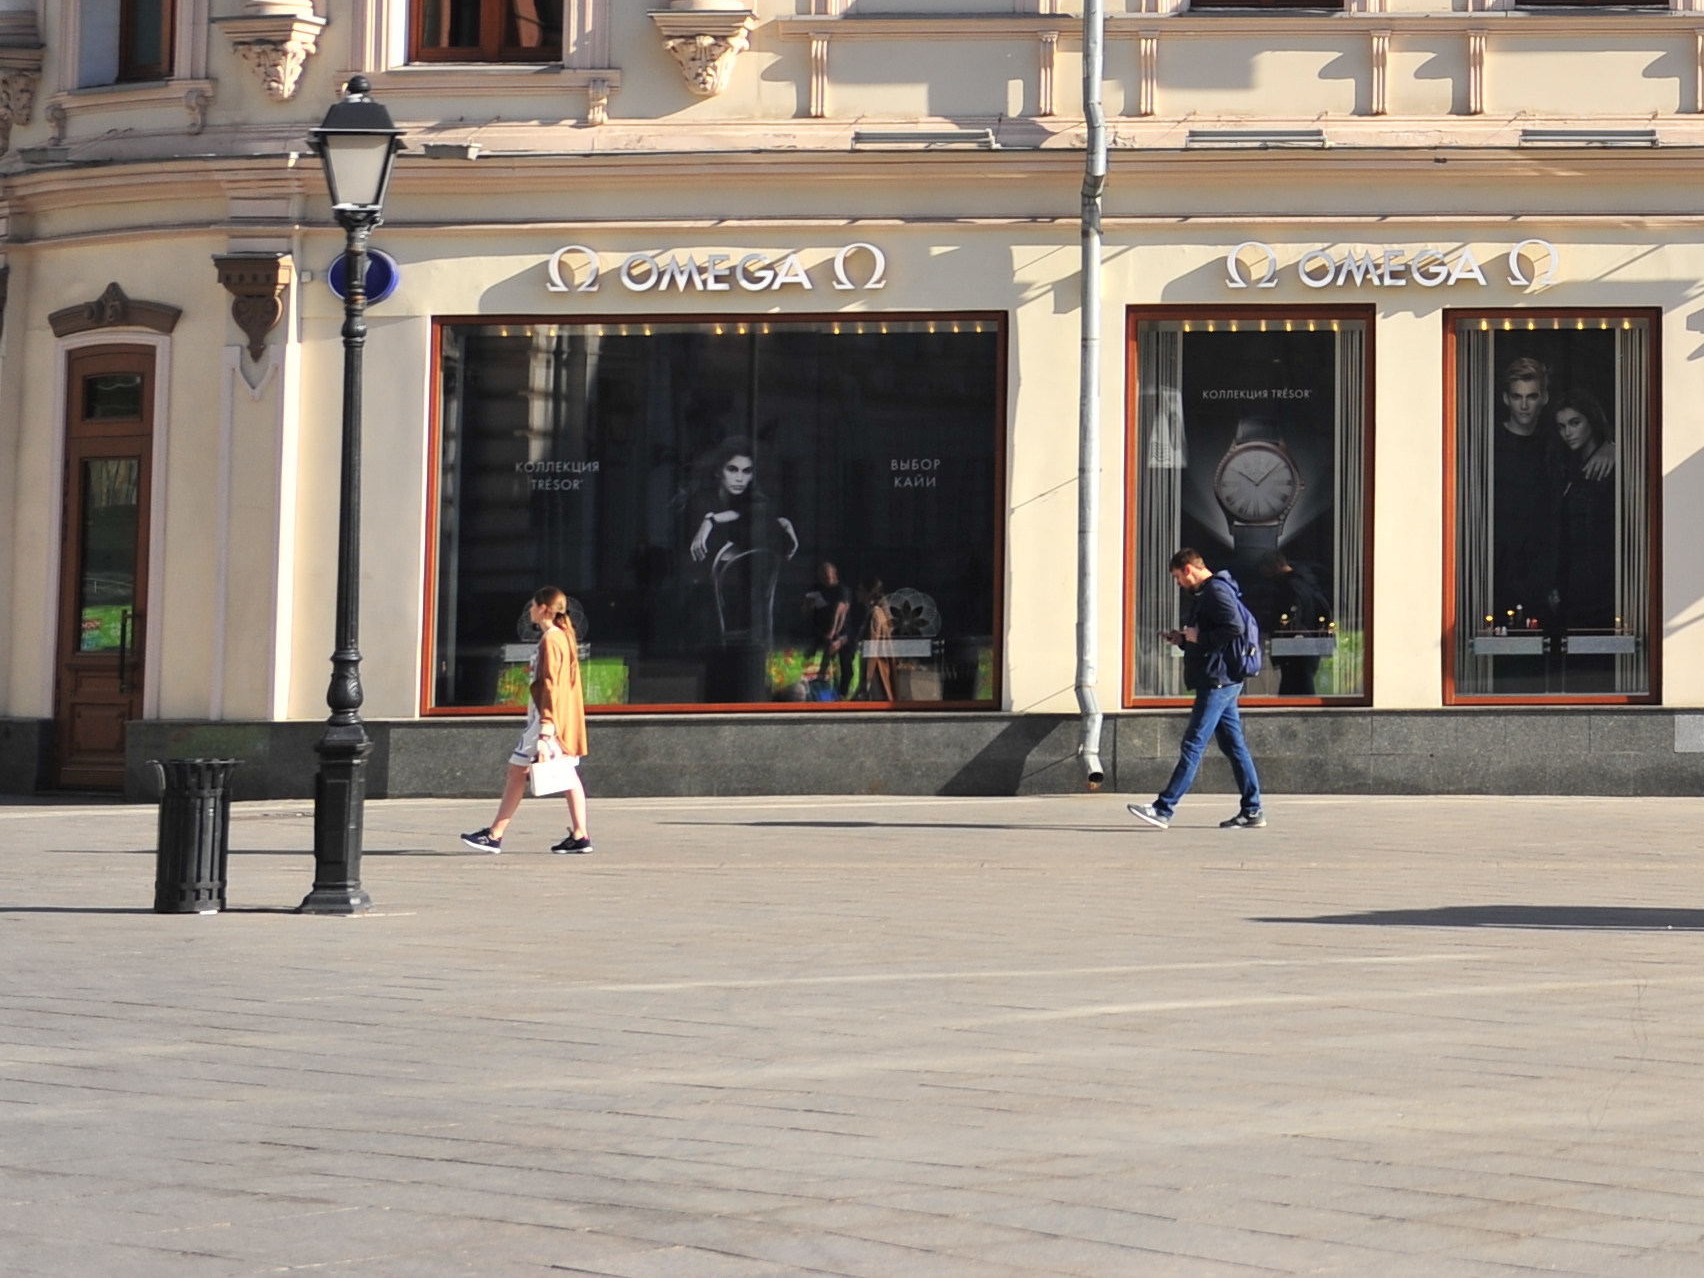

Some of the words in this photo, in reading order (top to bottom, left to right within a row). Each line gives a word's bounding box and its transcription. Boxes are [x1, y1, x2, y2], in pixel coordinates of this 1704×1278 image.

[620, 252, 813, 293] OMEGA
[1298, 248, 1488, 288] OMEGA
[1202, 389, 1269, 400] КОЛЛЕКЦИЯ
[515, 461, 600, 474] КОЛЛЕКЦИЯ
[890, 458, 941, 471] ВЫБОР
[894, 474, 936, 488] КАЙИ
